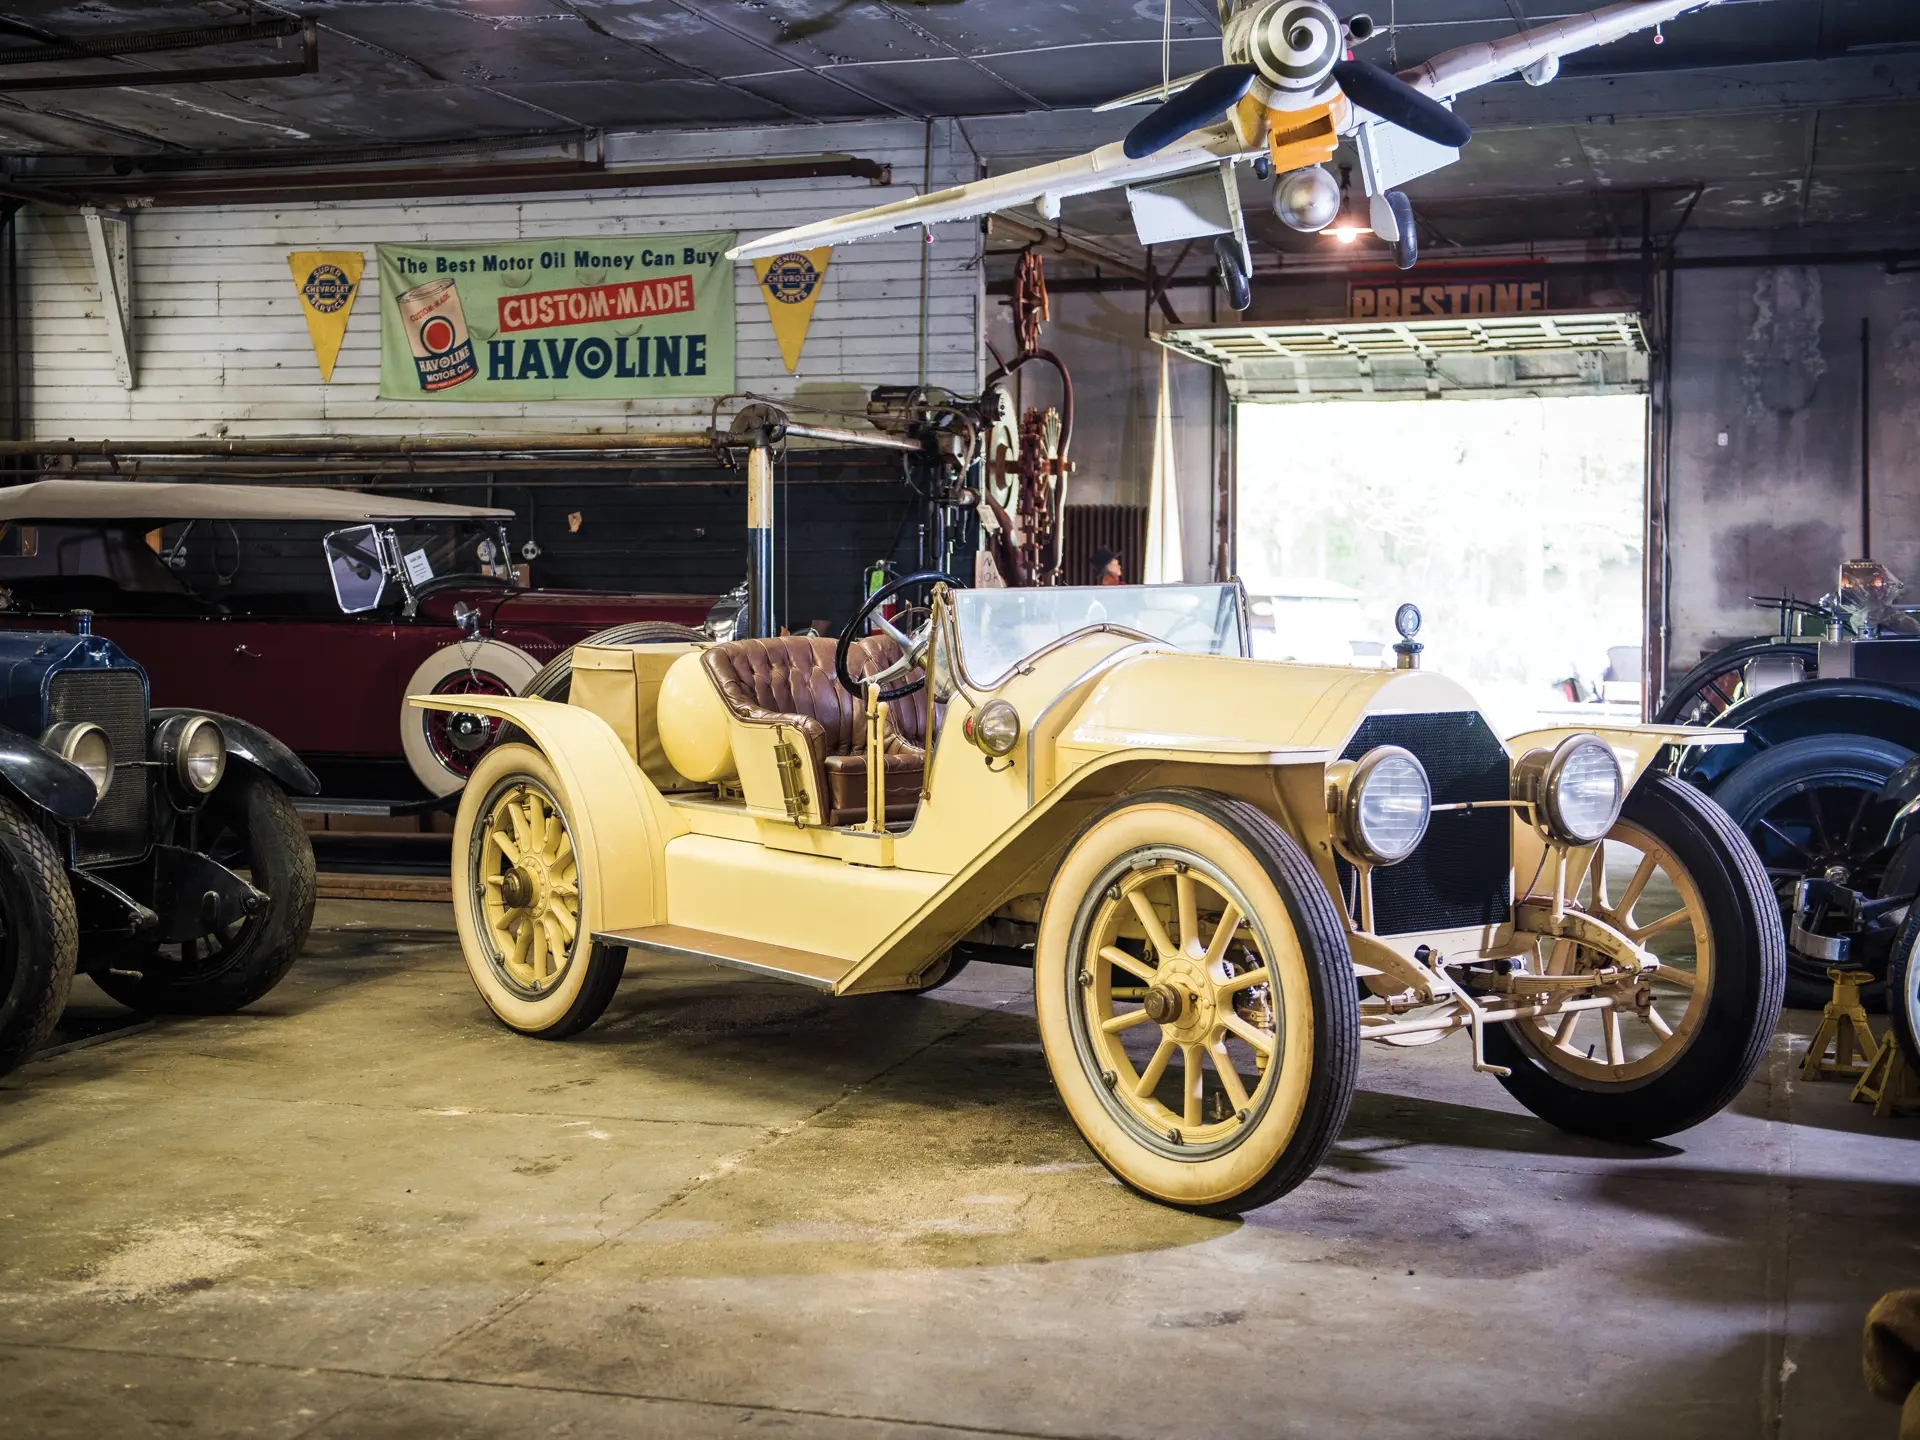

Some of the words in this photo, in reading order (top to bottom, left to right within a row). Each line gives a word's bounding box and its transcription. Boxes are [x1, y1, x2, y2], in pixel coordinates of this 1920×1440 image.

[397, 256, 428, 274] The
[436, 254, 476, 273] Best
[482, 255, 534, 272] Motor
[540, 251, 566, 269] Oil
[574, 250, 635, 270] Money
[641, 249, 675, 267] Can
[683, 247, 720, 267] Buy
[772, 255, 811, 271] GENUINE
[313, 265, 343, 278] SUPER
[767, 274, 816, 283] CHEVROLET
[305, 284, 350, 294] CHEVROLET
[776, 290, 808, 302] PARTS
[310, 295, 346, 313] SERVICE
[503, 280, 691, 329] CUSTOM-MADE
[1353, 283, 1541, 317] PRESTONE
[418, 345, 470, 373] HAVOLINE
[487, 334, 707, 381] HAVOLINE
[426, 368, 457, 382] MOTOR
[457, 362, 470, 374] OIL
